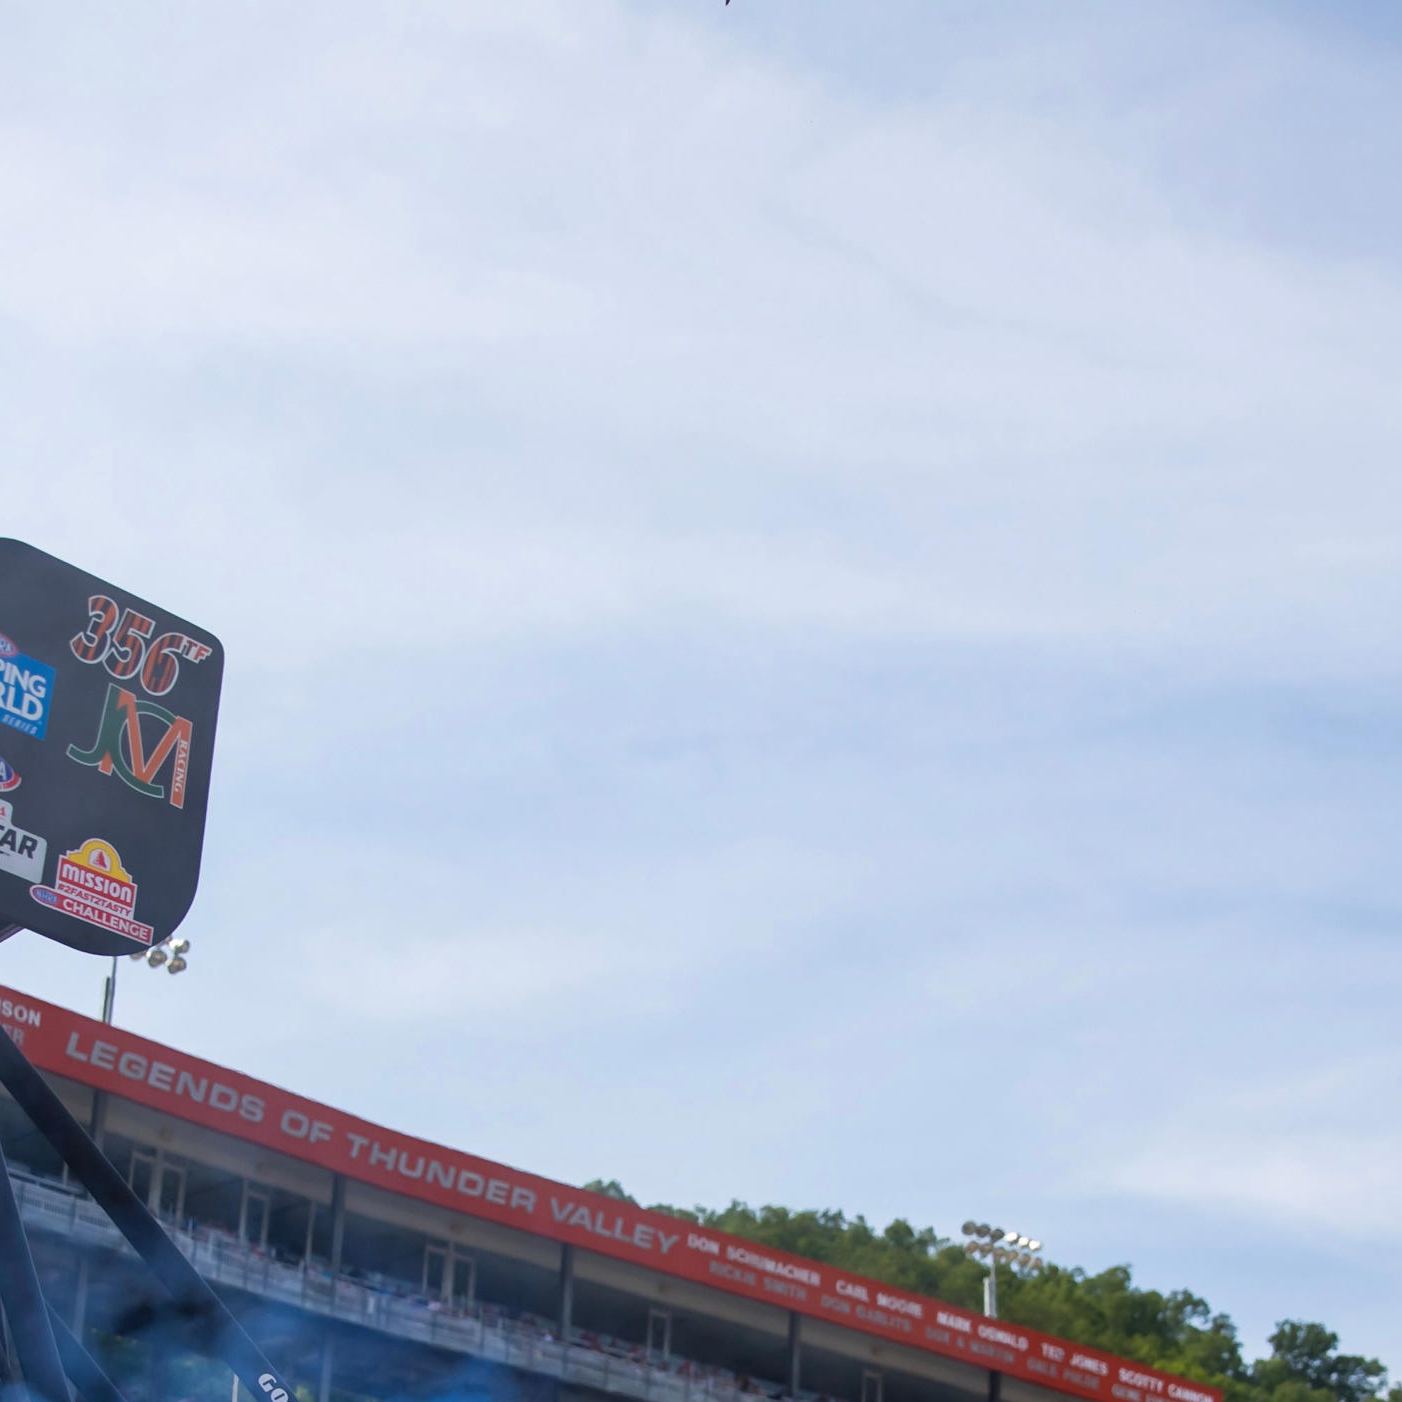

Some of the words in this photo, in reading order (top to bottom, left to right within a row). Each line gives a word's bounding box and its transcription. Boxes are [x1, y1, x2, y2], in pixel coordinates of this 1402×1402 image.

[70, 595, 179, 696] 356
[2, 711, 39, 736] SERIES
[174, 738, 189, 793] RACING
[61, 863, 132, 903] MISSION
[62, 898, 149, 940] CHALLENGE
[64, 1032, 266, 1124] LEGENDS
[279, 1112, 335, 1144] OF
[346, 1132, 537, 1214] THUNDER
[549, 1197, 680, 1255] VALLEY
[688, 1232, 720, 1256] DON
[937, 1311, 972, 1334] MARK
[977, 1324, 1029, 1351] OSWALD
[1069, 1351, 1109, 1377] JONES
[1117, 1367, 1166, 1395] SCOTTY
